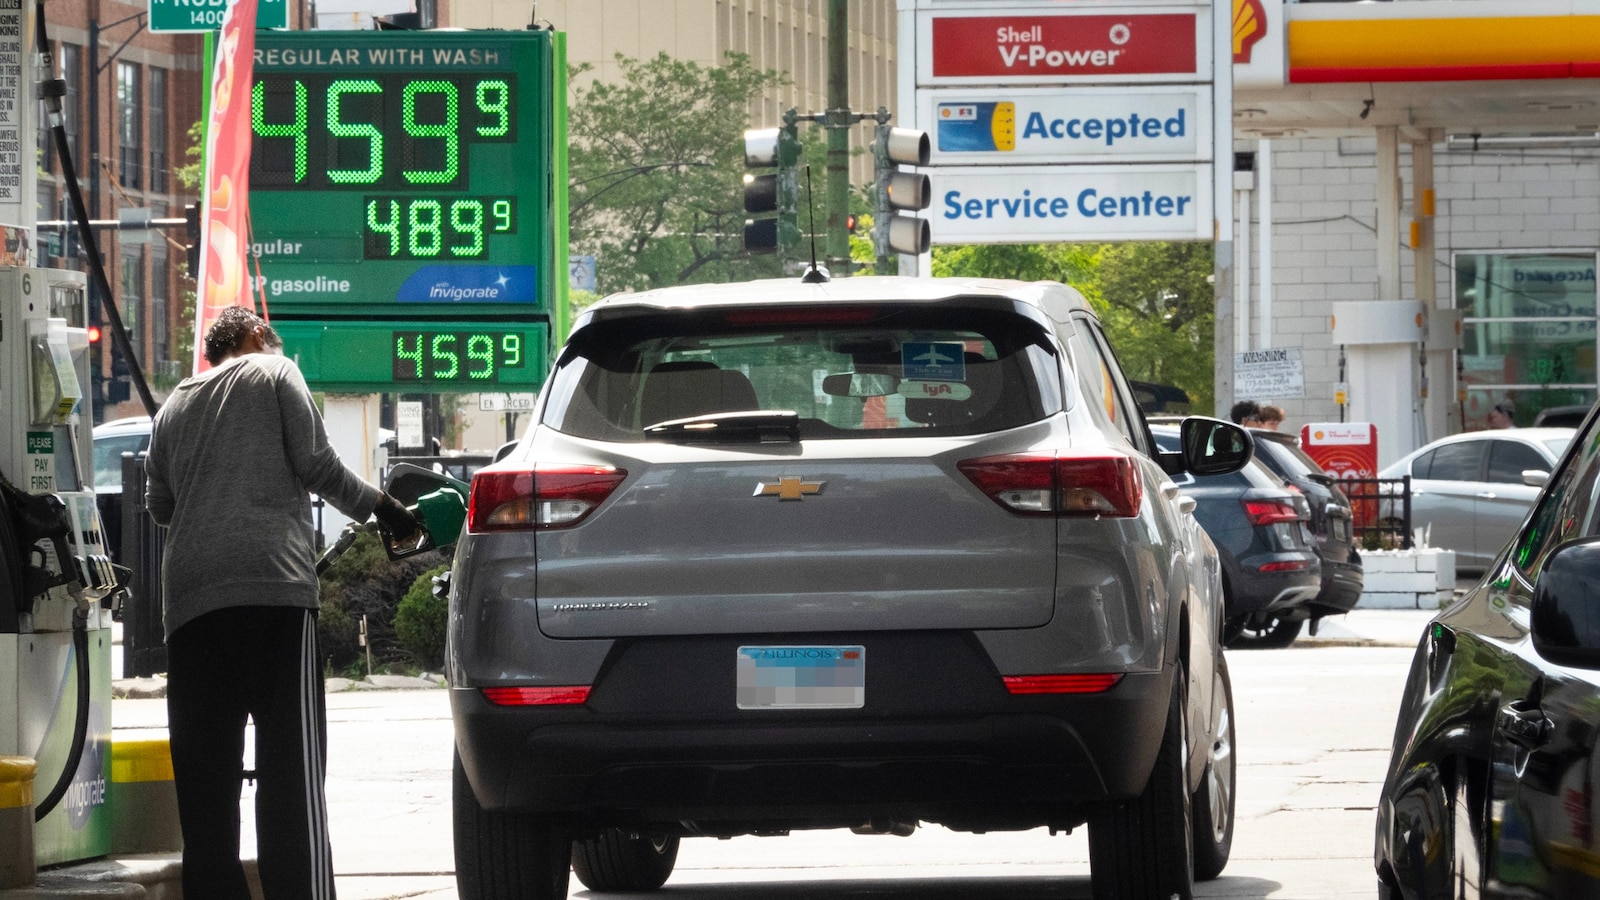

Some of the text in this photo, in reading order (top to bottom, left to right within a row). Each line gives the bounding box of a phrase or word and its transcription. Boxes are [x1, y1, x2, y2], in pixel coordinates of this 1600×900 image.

[997, 26, 1042, 43] Shell
[253, 48, 500, 66] REGULAR WITH WASH
[998, 45, 1120, 68] V-Power
[5, 77, 17, 87] THE
[1022, 108, 1186, 146] Accepted
[8, 153, 16, 163] TO
[943, 188, 1192, 220] Service Center
[22, 273, 32, 295] 6
[271, 276, 351, 296] gasoline
[430, 284, 499, 301] Invigorate
[1243, 350, 1287, 364] WARNING
[29, 437, 53, 449] PLEASE
[34, 458, 48, 472] PAY
[31, 476, 53, 491] FIRST
[771, 648, 833, 659] ILLINOIS
